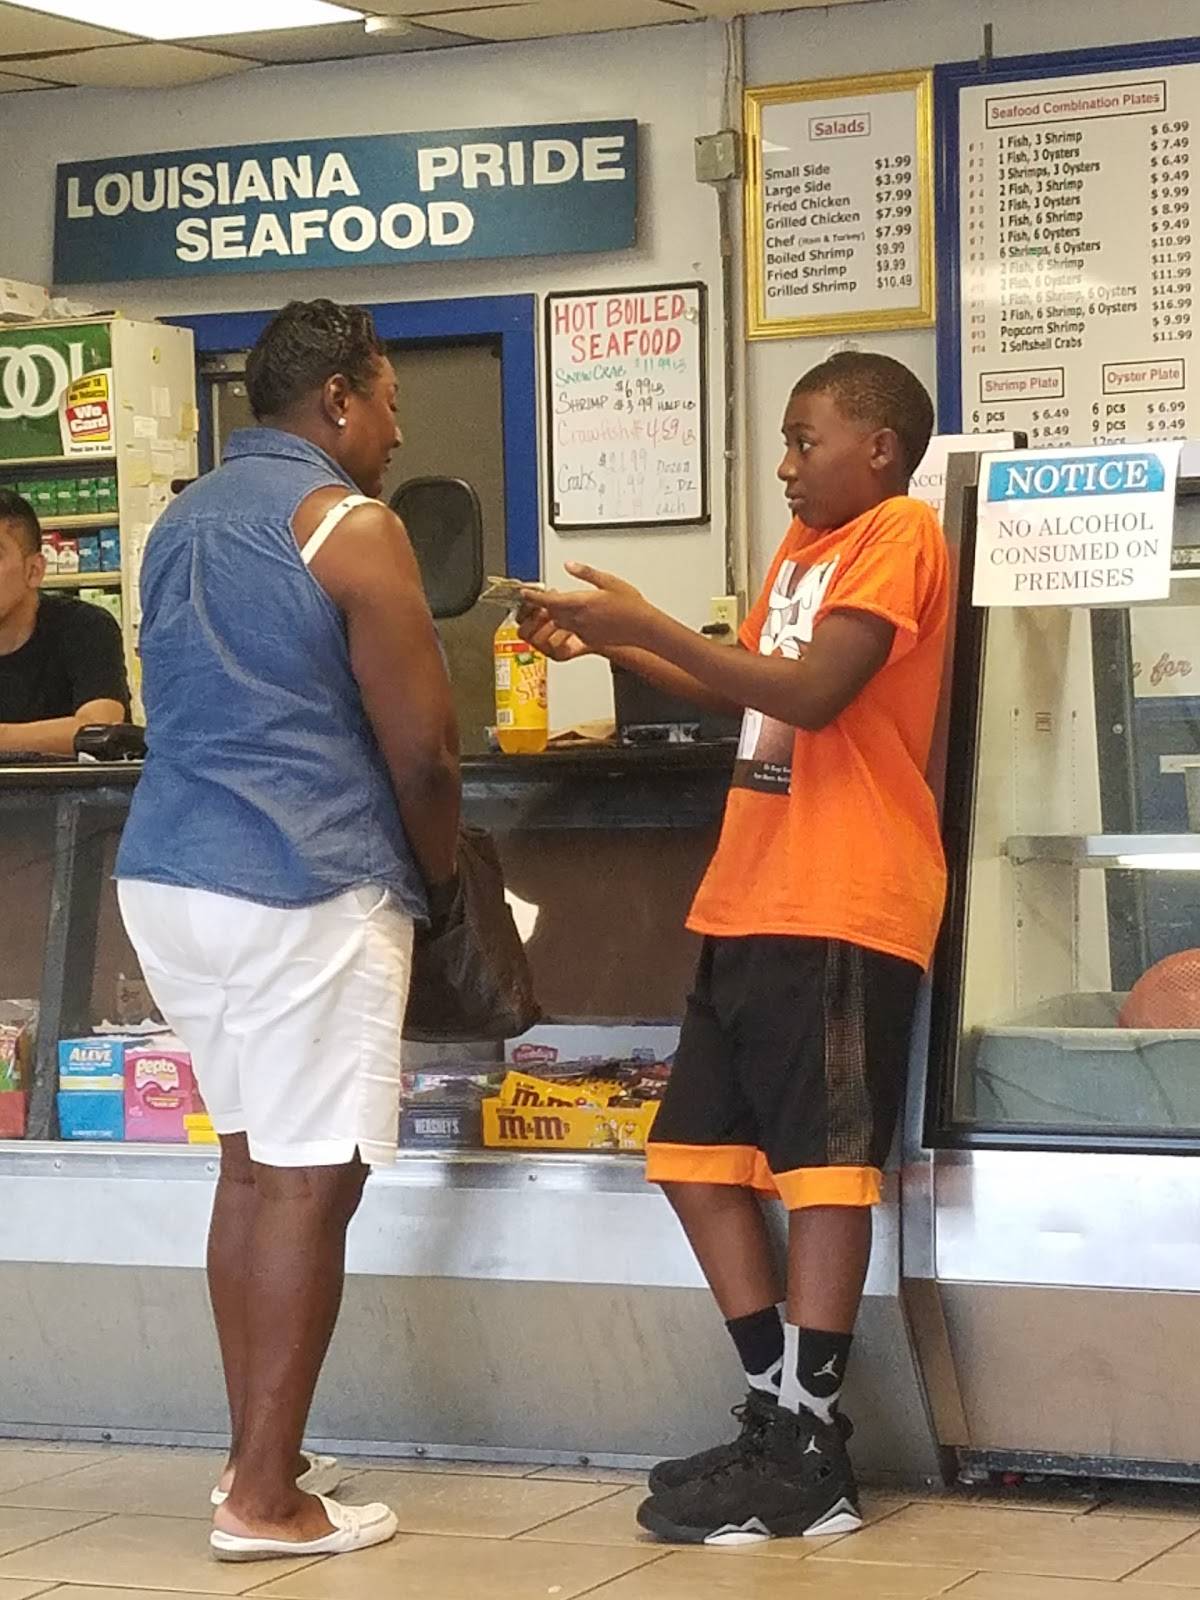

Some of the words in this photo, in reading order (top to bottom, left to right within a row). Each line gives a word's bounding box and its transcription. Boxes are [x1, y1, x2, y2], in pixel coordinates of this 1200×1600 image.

[991, 100, 1039, 120] Seafood
[1043, 95, 1119, 114] Combination
[1123, 92, 1160, 105] Plates
[814, 119, 865, 137] Salads
[999, 137, 1003, 149] 1
[1008, 135, 1032, 147] Fish,
[1035, 133, 1041, 145] 3
[1045, 132, 1082, 144] Shrimp
[1162, 121, 1189, 134] 6.99
[999, 153, 1003, 164] 1
[1007, 152, 1030, 164] Fish,
[1033, 150, 1039, 161] 3
[1042, 148, 1080, 161] Oysters
[1162, 137, 1189, 149] 7.49
[66, 152, 360, 219] LOUISIANA
[417, 136, 627, 192] PRIDE
[764, 167, 799, 180] Small
[803, 164, 830, 177] Side
[875, 155, 911, 170] $1.99
[999, 169, 1004, 180] 3
[1008, 167, 1050, 179] Shrimps,
[1054, 163, 1059, 175] 3
[1062, 162, 1100, 175] Oysters
[1162, 153, 1189, 166] 6.49
[765, 185, 801, 197] Large
[804, 181, 831, 193] Side
[875, 172, 912, 186] $3.99
[999, 184, 1005, 196] 2
[1008, 183, 1032, 195] Fish,
[1036, 181, 1042, 192] 3
[1046, 179, 1083, 192] Shrimp
[1162, 170, 1189, 182] 9.49
[766, 201, 797, 213] Fried
[801, 196, 850, 210] Chicken
[876, 188, 912, 204] $7.99
[999, 200, 1005, 211] 2
[1008, 199, 1031, 211] Fish,
[1034, 197, 1040, 208] 3
[1043, 196, 1080, 208] Oysters
[1162, 186, 1189, 198] 9.99
[766, 216, 807, 230] Grilled
[811, 212, 860, 225] Chicken
[876, 205, 912, 220] $7.99
[1000, 216, 1004, 227] 1
[1008, 215, 1032, 226] Fish,
[1036, 213, 1042, 224] 6
[1045, 211, 1083, 223] Shrimp
[1162, 202, 1189, 214] 8.99
[175, 202, 475, 264] SEAFOOD
[766, 234, 795, 248] Chef
[876, 223, 912, 238] $7.99
[1000, 232, 1004, 243] 1
[1008, 230, 1030, 242] Fish,
[1034, 228, 1039, 240] 6
[1043, 228, 1080, 240] Oysters
[1162, 218, 1189, 231] 9.49
[767, 251, 805, 264] Boiled
[809, 247, 854, 260] Shrimp
[1000, 247, 1006, 258] 6
[1008, 245, 1050, 257] Shrimps,
[1054, 243, 1060, 254] 6
[1063, 241, 1101, 255] Oysters
[1151, 235, 1191, 248] $10.99
[1152, 251, 1191, 265] $11.99
[767, 268, 798, 281] Fried
[802, 265, 847, 278] Shrimp
[876, 258, 906, 272] $9.99
[1152, 267, 1191, 280] $11.99
[767, 284, 808, 297] Grilled
[812, 280, 857, 294] Shrimp
[877, 274, 912, 288] $10.49
[1152, 283, 1191, 296] $14.99
[554, 301, 598, 335] HOT
[606, 294, 686, 328] BOILED
[1001, 310, 1006, 321] 2
[1010, 309, 1033, 320] Fish,
[1037, 307, 1043, 319] 6
[1046, 306, 1085, 318] Shrimp,
[1088, 303, 1095, 315] 6
[1098, 302, 1137, 316] Oysters
[1152, 298, 1192, 311] $16.99
[1001, 325, 1043, 338] Popcorn
[1047, 321, 1085, 334] Shrimp
[1163, 313, 1190, 326] 9.99
[571, 328, 682, 364] SEAFOOD
[1001, 342, 1006, 353] 2
[1009, 338, 1051, 352] Softshell
[1055, 337, 1082, 349] Crabs
[1153, 330, 1192, 343] $11.99
[985, 379, 1027, 392] Shrimp
[1030, 377, 1058, 389] Plate
[1107, 371, 1147, 385] Oyster
[1150, 368, 1180, 380] Plate
[972, 410, 979, 422] 6
[986, 411, 1005, 425] pcs
[1042, 408, 1069, 420] 6.49
[1092, 402, 1099, 415] 6
[1106, 403, 1125, 416] pcs
[1158, 401, 1185, 412] 6.99
[1042, 425, 1069, 437] 8.49
[1092, 419, 1099, 432] 9
[1106, 420, 1125, 433] pcs
[1158, 419, 1185, 430] 9.49
[1004, 458, 1149, 496] NOTICE
[998, 519, 1031, 538] NO
[1038, 512, 1154, 538] ALCOHOL
[990, 542, 1120, 565] CONSUMED
[1126, 539, 1159, 558] ON
[1014, 568, 1134, 591] PREMISES
